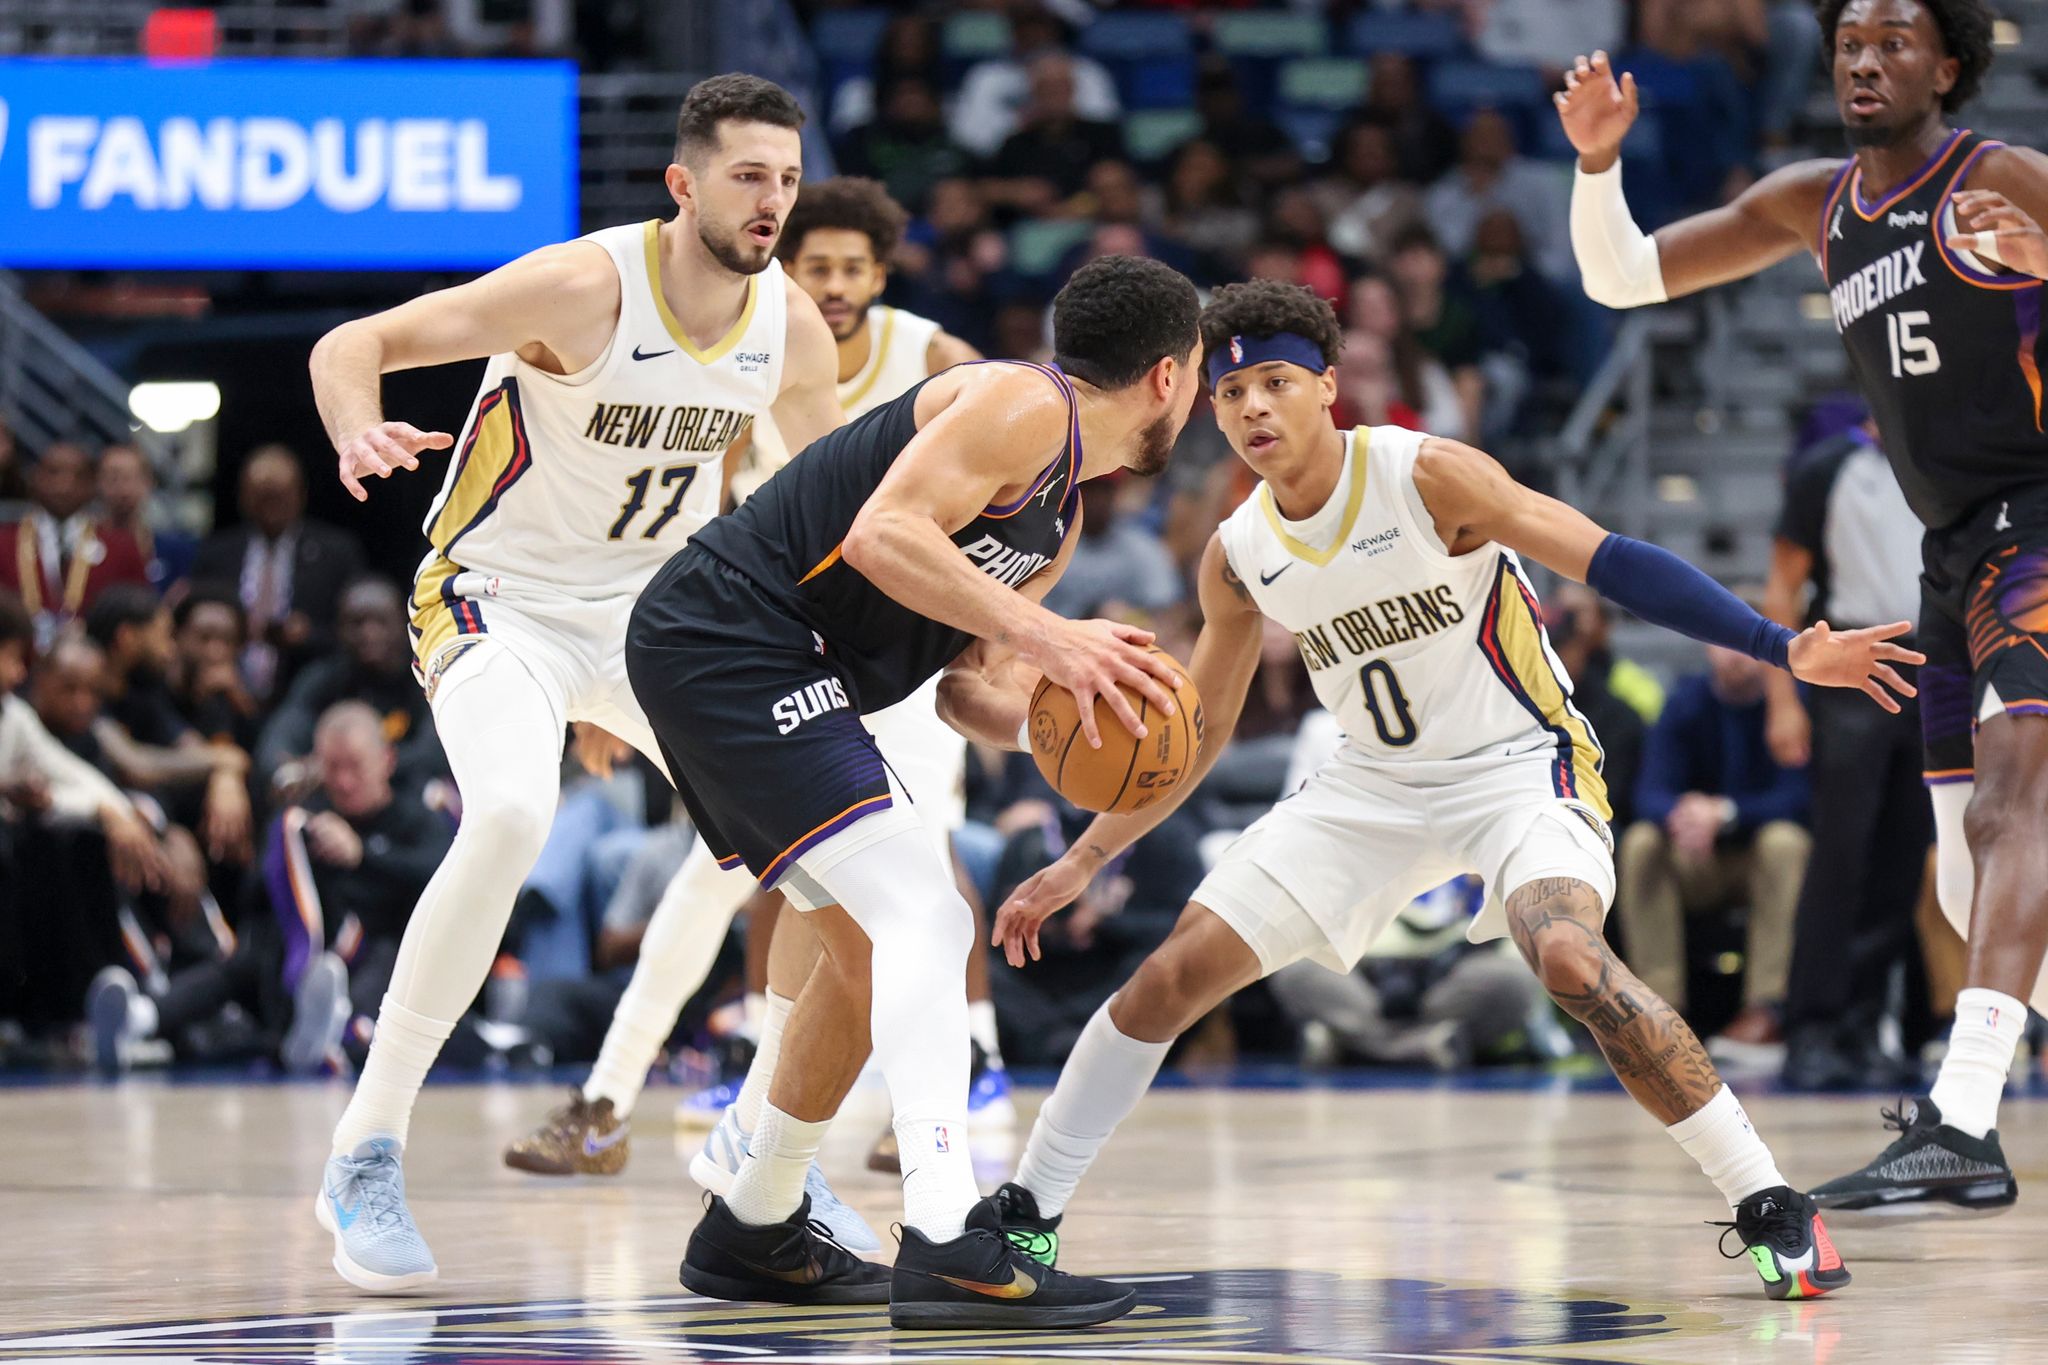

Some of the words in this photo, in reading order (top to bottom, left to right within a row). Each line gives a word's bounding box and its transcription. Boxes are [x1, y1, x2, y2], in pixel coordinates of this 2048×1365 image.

[27, 116, 522, 212] FANDUEL
[1829, 240, 1928, 335] PHOENIX
[735, 352, 770, 364] NEWAGE
[1887, 310, 1941, 377] 15
[584, 402, 666, 449] NEW
[663, 406, 755, 451] ORLEAN
[608, 463, 699, 541] 17
[1352, 527, 1401, 552] NEWAGE
[1331, 584, 1465, 656] ORLEANS
[771, 676, 850, 735] SUNS
[1360, 656, 1419, 747] 0
